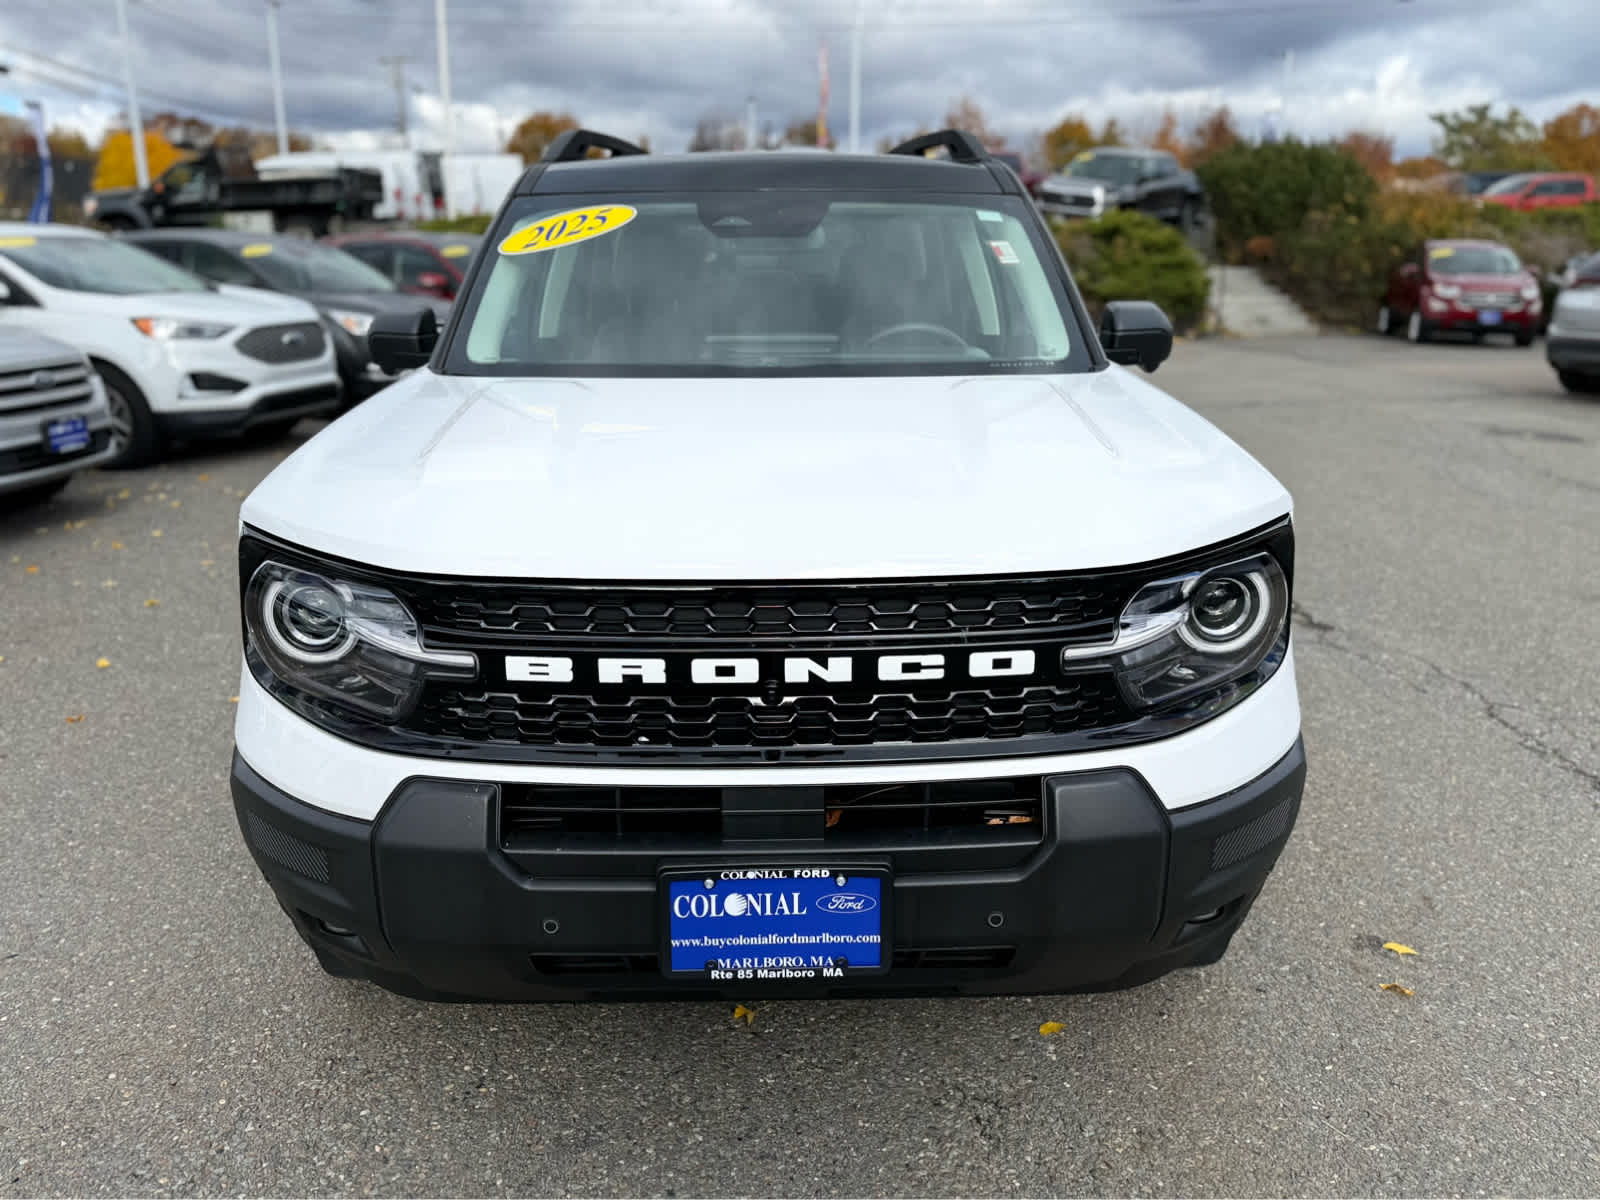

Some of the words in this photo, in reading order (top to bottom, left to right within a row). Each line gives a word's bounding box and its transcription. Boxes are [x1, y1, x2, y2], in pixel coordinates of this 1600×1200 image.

[522, 207, 613, 249] 2025
[505, 650, 1035, 684] BRONCO
[793, 869, 830, 879] FORD
[828, 895, 864, 910] Ford
[671, 933, 881, 949] www.buycolonialfordmarlboro.com
[810, 956, 834, 967] MA
[711, 970, 733, 979] Rte
[737, 969, 754, 979] 85
[757, 968, 815, 979] Marlboro
[823, 967, 844, 977] MA
